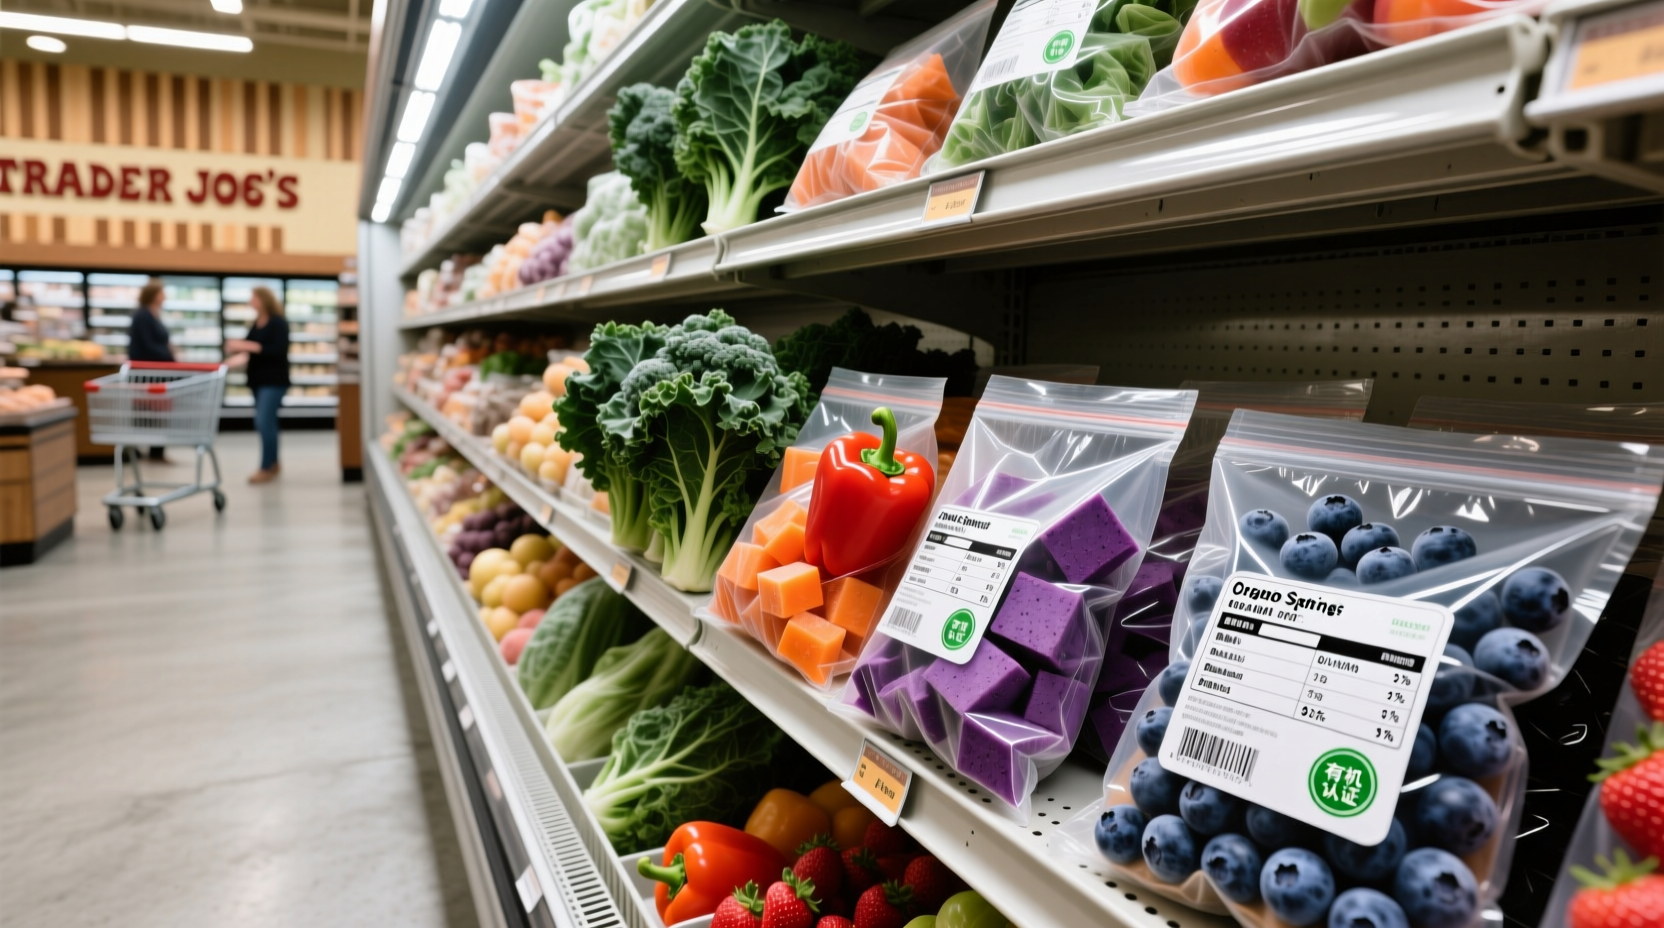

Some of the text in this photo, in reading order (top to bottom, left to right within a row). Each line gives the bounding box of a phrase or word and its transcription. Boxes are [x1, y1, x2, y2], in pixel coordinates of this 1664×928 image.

[0, 159, 173, 204] TRADER
[1324, 762, 1362, 788] 有机
[1322, 781, 1360, 806] 认证
